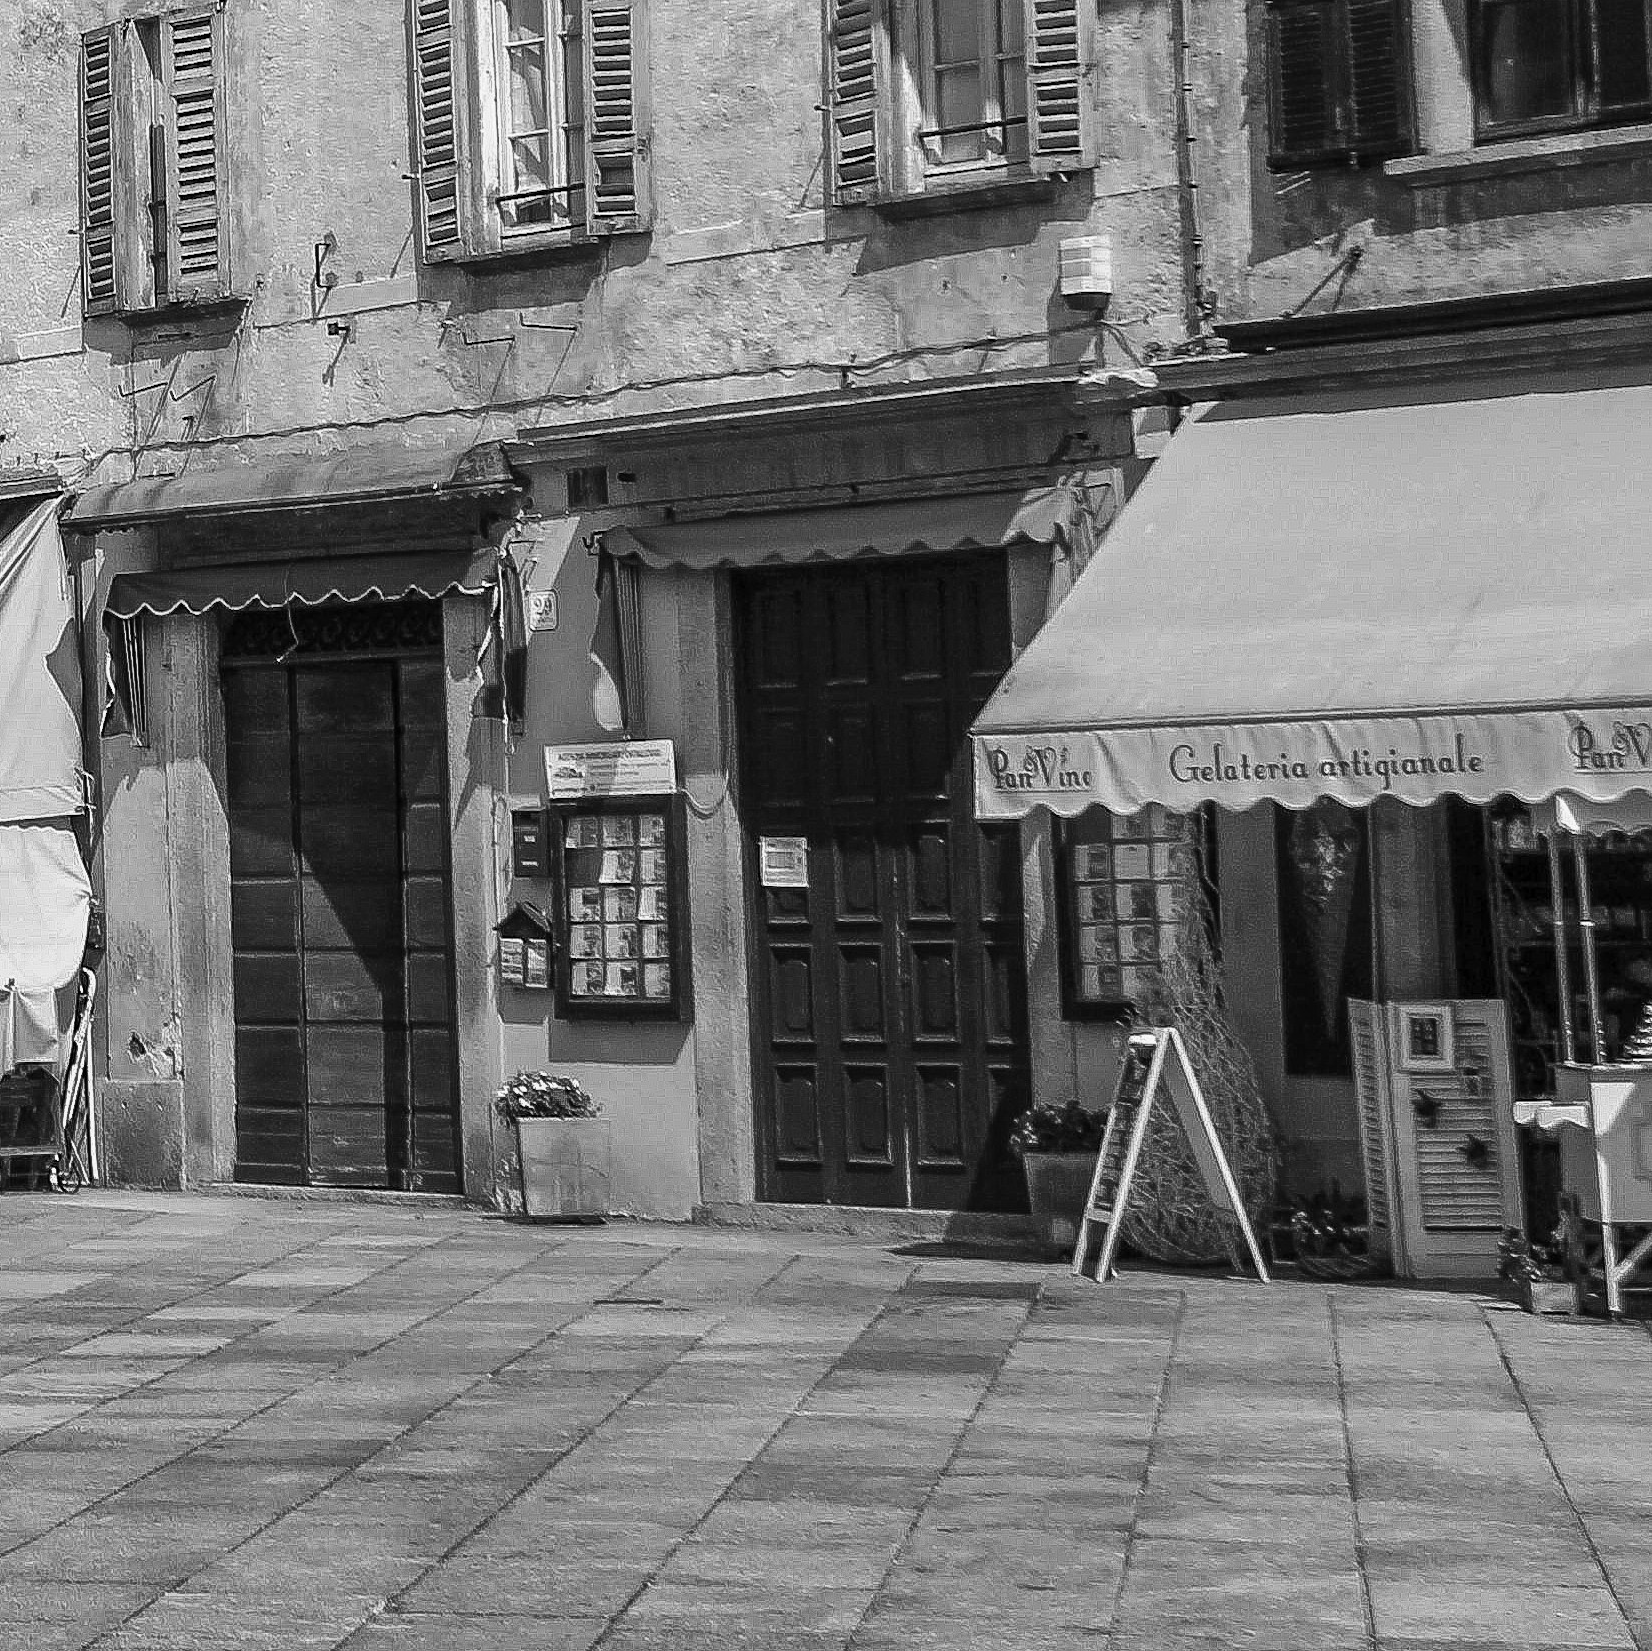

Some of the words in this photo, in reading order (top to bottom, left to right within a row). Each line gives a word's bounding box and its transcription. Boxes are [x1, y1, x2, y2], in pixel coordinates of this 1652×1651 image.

[1168, 743, 1309, 784] Gelateria
[1318, 730, 1483, 790] artigianale
[1568, 723, 1625, 769] Pan
